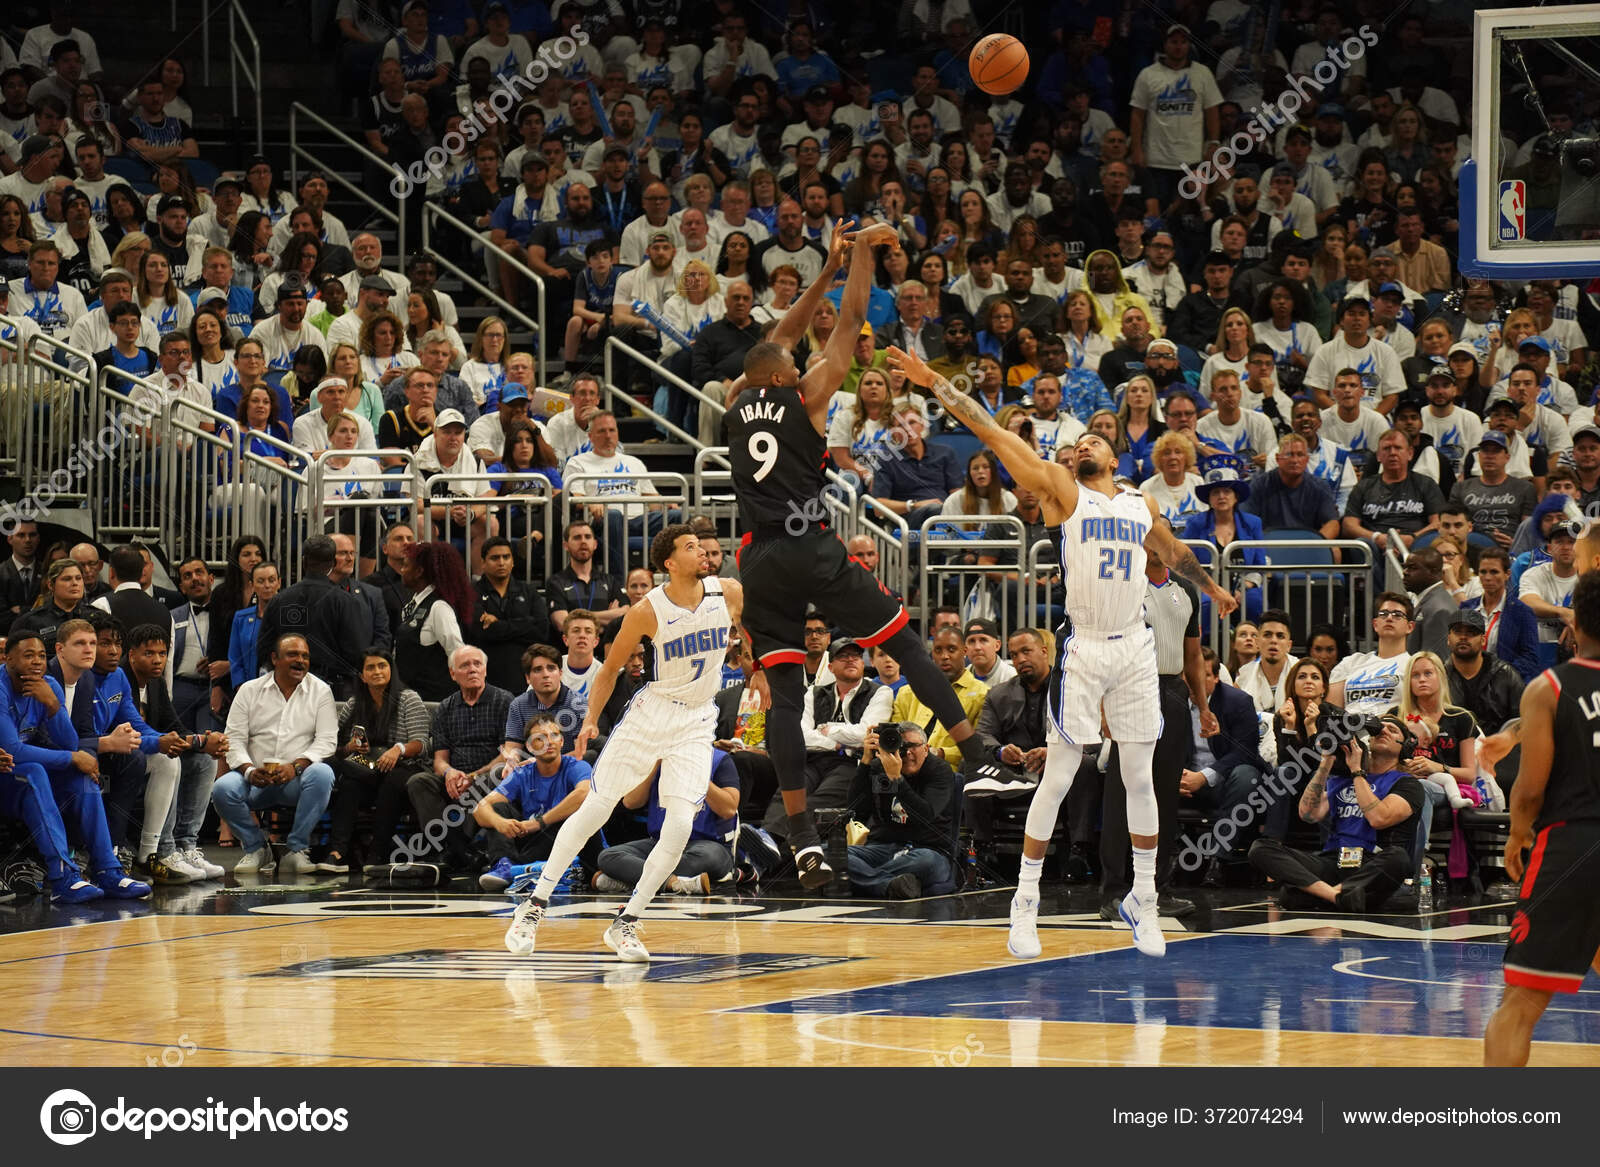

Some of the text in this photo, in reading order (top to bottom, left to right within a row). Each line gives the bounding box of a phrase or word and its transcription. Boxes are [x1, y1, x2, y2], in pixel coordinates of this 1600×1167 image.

[1501, 227, 1515, 238] NBA
[739, 401, 786, 424] IBAKA
[748, 431, 779, 483] 9
[1395, 499, 1425, 514] Blue
[1080, 516, 1147, 547] MAGIC
[1098, 547, 1133, 582] 24
[663, 626, 729, 662] MAGIC
[691, 657, 706, 681] 7
[1346, 687, 1395, 704] IGNITE
